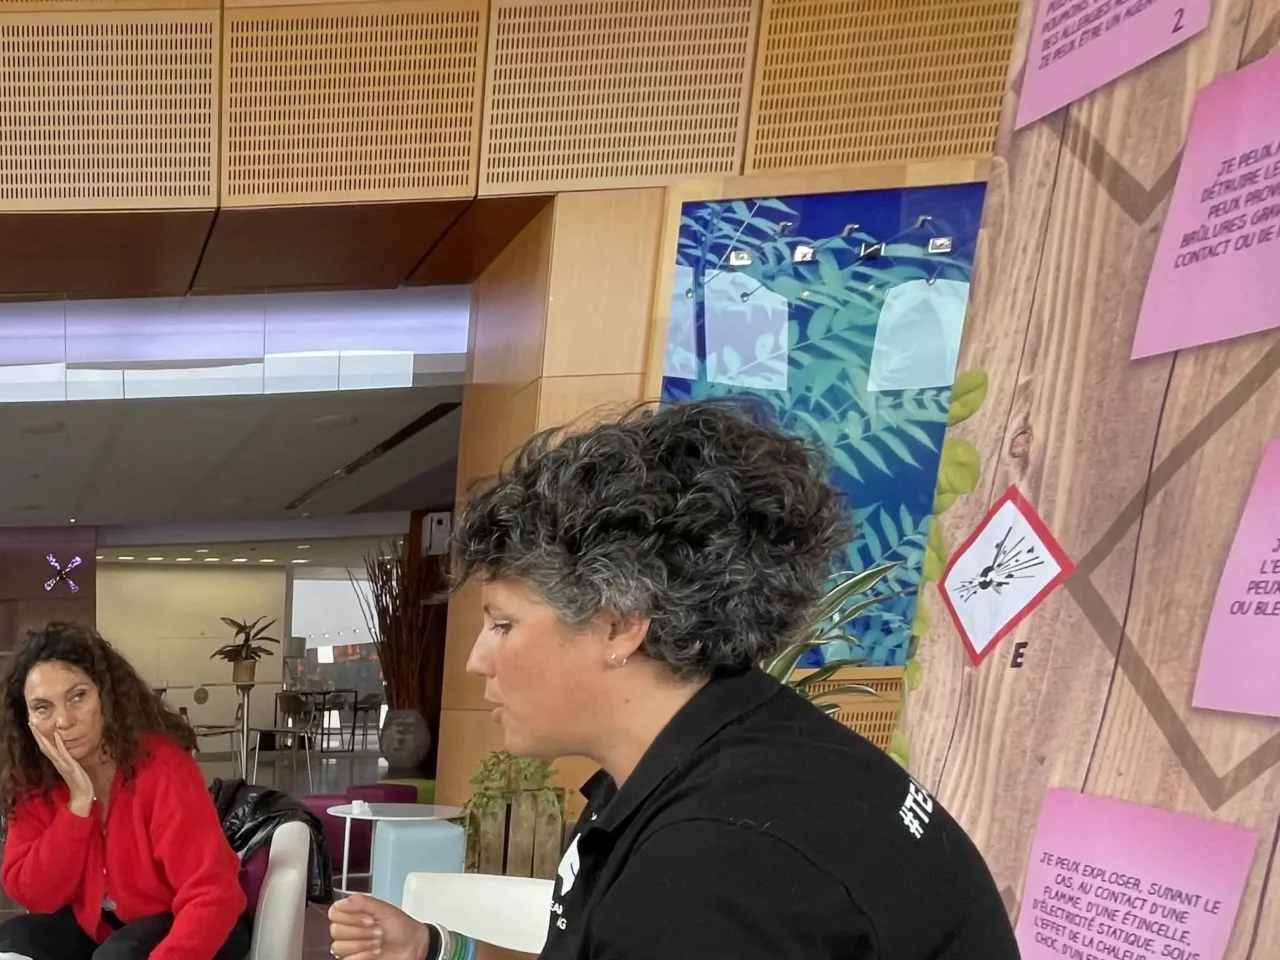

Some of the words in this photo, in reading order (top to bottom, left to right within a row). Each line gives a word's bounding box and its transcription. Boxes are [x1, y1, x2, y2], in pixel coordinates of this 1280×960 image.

[1171, 7, 1185, 34] 2
[1217, 157, 1237, 178] JE
[1200, 168, 1262, 204] DÉTRUIRE
[1207, 196, 1241, 220] PEUX
[1174, 239, 1232, 269] CONTACT
[1234, 231, 1256, 251] OU
[1257, 225, 1277, 245] DE
[1180, 214, 1248, 249] BRÛLURES
[1246, 580, 1280, 595] PEUX
[1230, 601, 1252, 615] OU
[1010, 642, 1028, 668] E
[899, 776, 933, 839] #TE
[1039, 852, 1055, 866] JE
[1055, 856, 1081, 874] PEUX
[1082, 864, 1143, 894] EXPLOSER,
[1148, 882, 1203, 909] SUIVANT
[1203, 898, 1222, 915] LE
[1055, 873, 1075, 891] CAS,
[1077, 881, 1093, 895] AU
[1094, 885, 1148, 911] CONTACT
[1149, 902, 1190, 925] D'UNE
[1032, 898, 1096, 932] D'ÉLECTRICITÉ
[1096, 922, 1156, 955] STATIQUE,
[1034, 915, 1067, 937] L'EFFET
[1068, 929, 1081, 944] DE
[1081, 934, 1094, 950] LA
[1043, 886, 1083, 912] FLAMME,
[1086, 901, 1120, 922] D'UNE
[1121, 910, 1192, 946] ÉTINCELLE,
[1035, 932, 1059, 953] CHOC,
